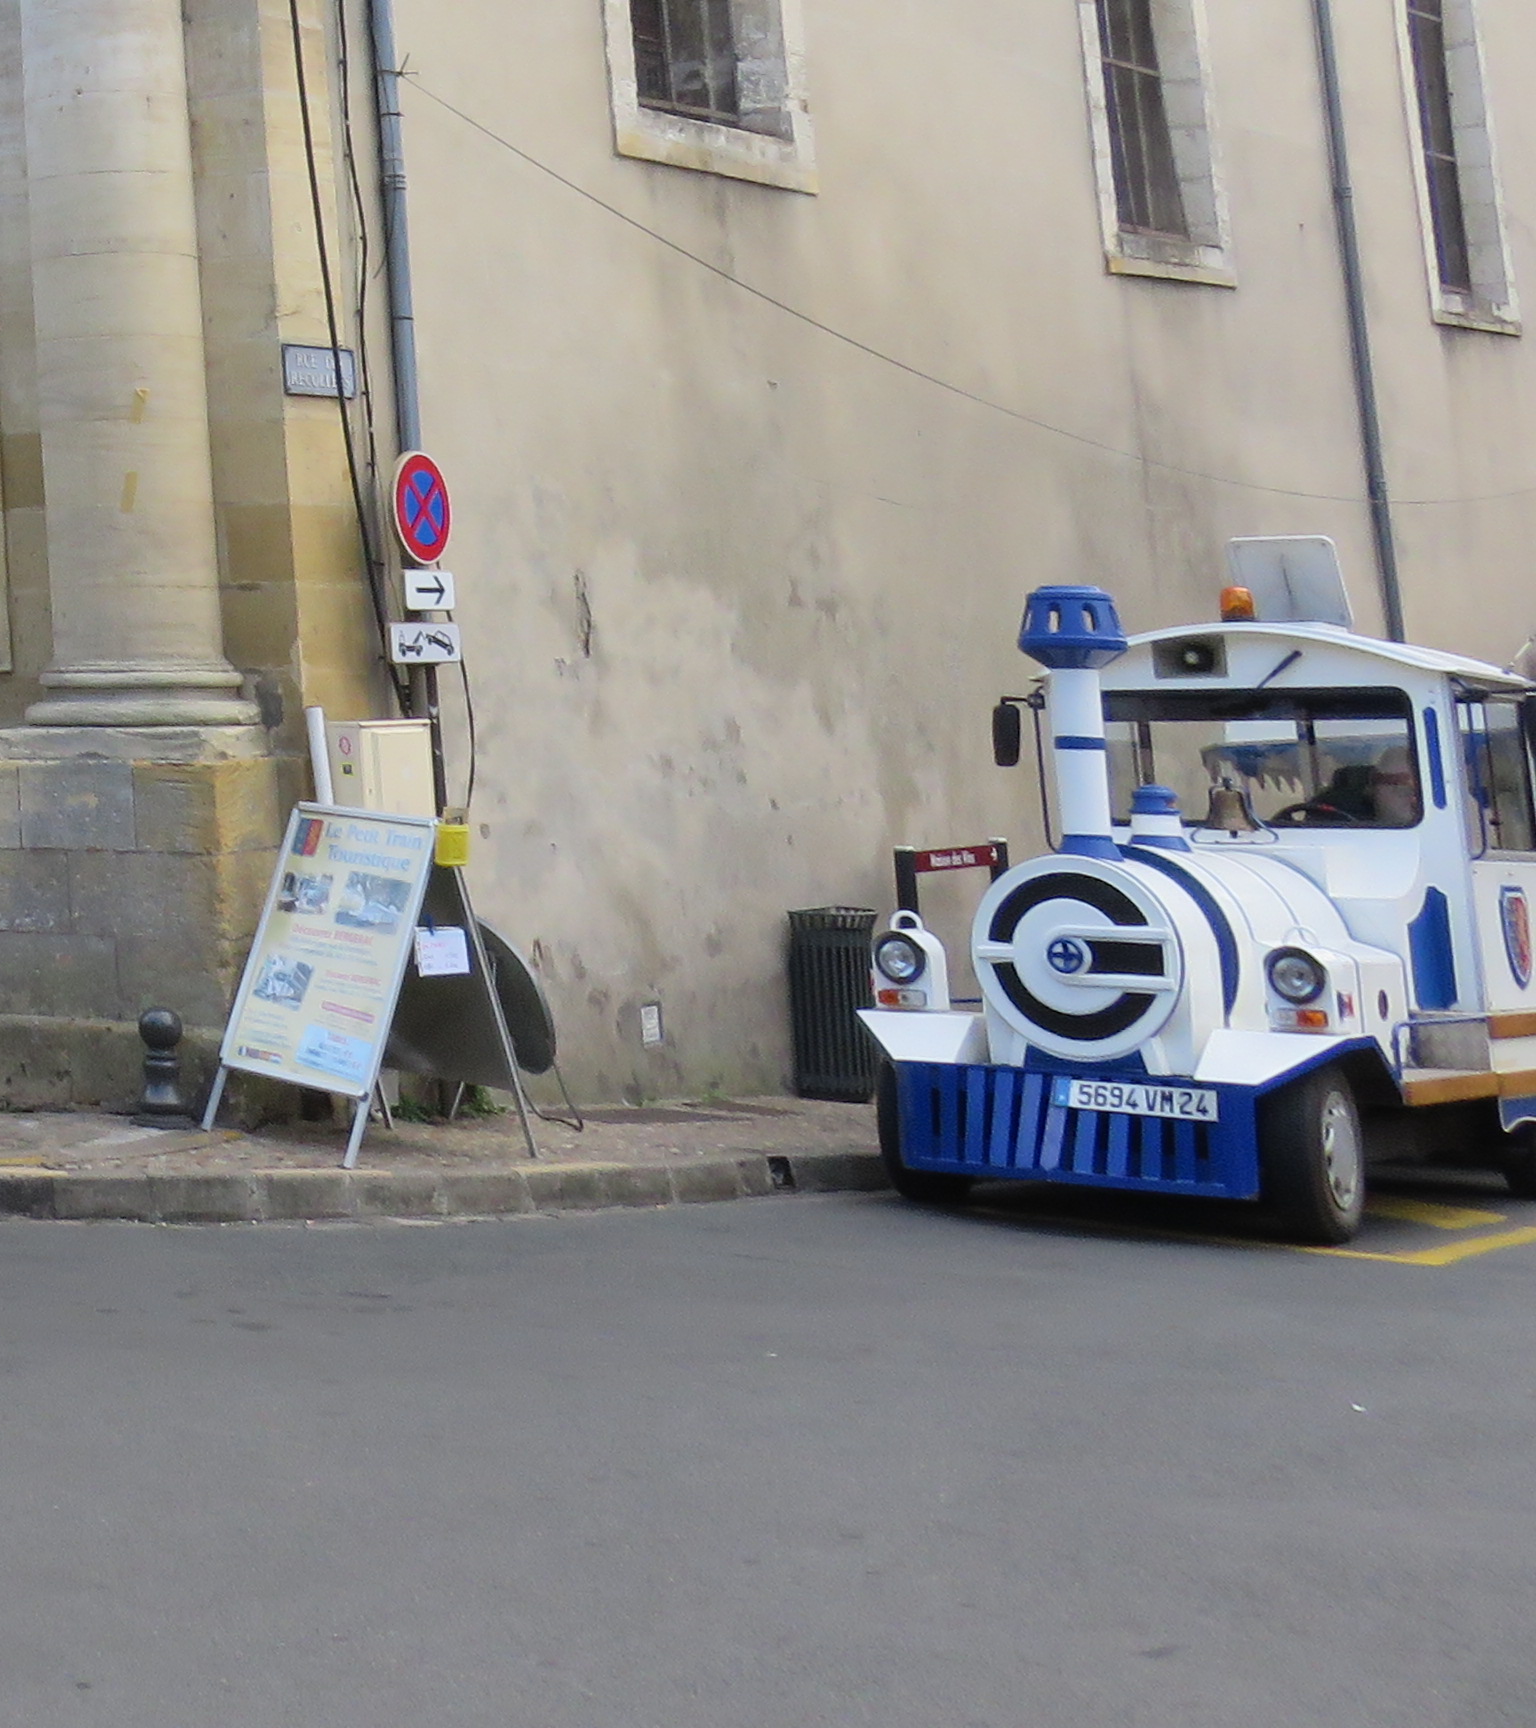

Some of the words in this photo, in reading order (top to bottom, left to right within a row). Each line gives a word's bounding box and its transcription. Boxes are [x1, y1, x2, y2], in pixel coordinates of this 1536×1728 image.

[325, 821, 343, 839] Le
[347, 824, 379, 844] Petit
[386, 829, 424, 850] Train
[328, 844, 412, 872] Touristique
[1077, 1084, 1139, 1110] 5694
[1143, 1087, 1174, 1113] VM
[1178, 1091, 1209, 1117] 24
